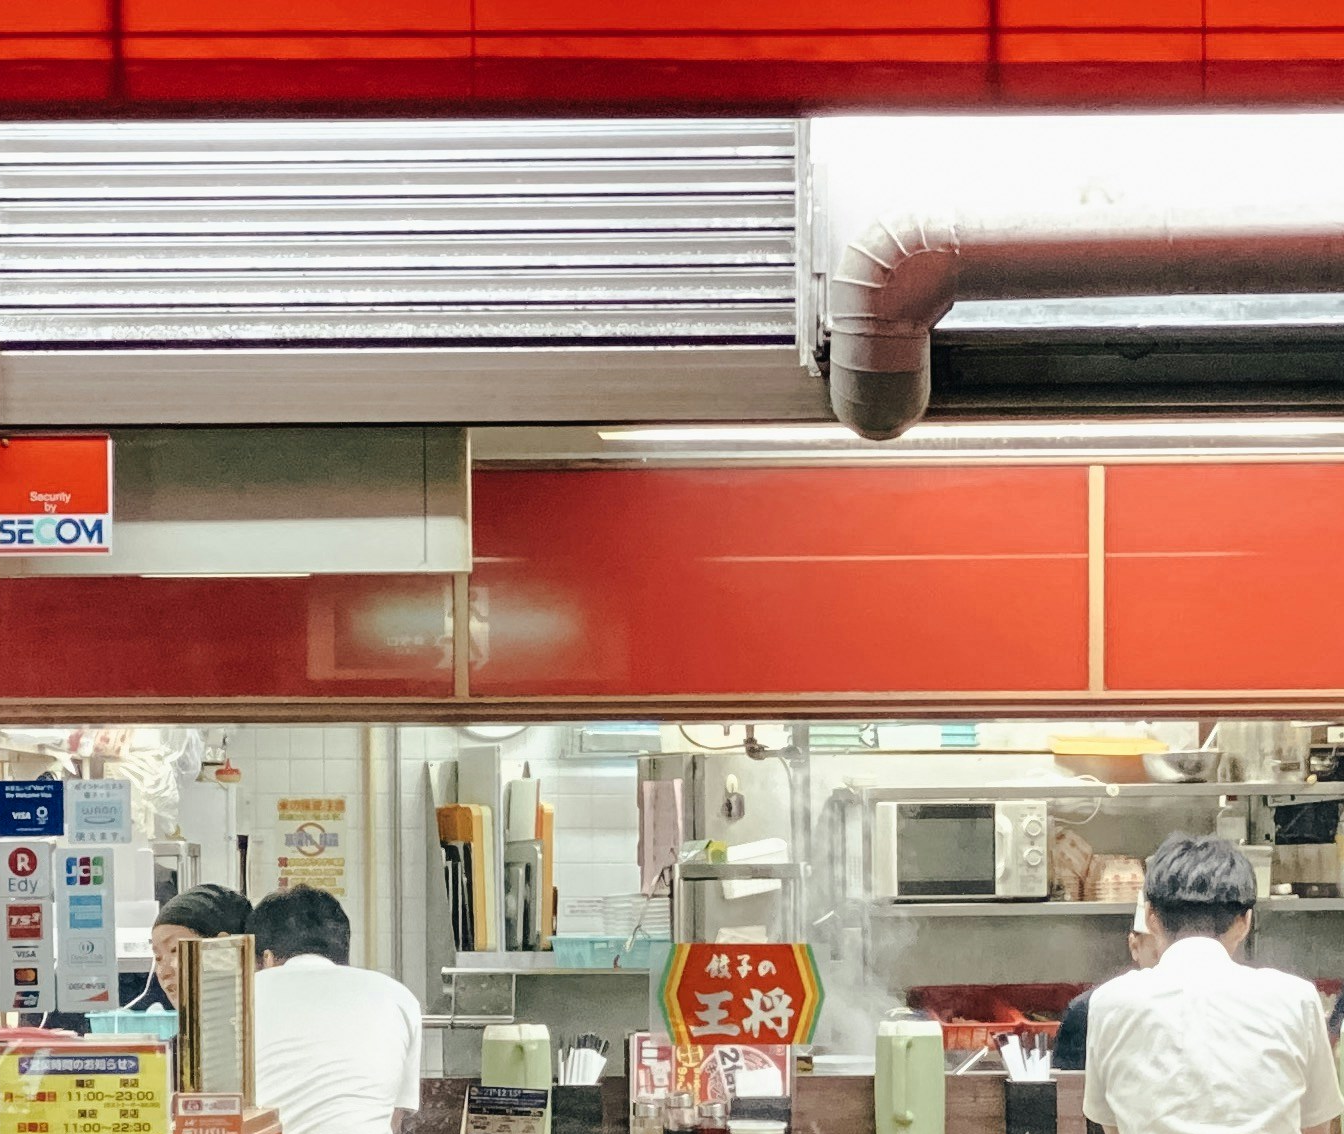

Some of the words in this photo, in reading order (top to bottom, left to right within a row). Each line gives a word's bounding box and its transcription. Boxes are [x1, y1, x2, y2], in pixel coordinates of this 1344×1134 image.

[30, 490, 71, 504] Security
[44, 502, 57, 513] by
[12, 811, 31, 820] VISA
[8, 877, 38, 894] Edy
[705, 954, 777, 978] 餃子の
[689, 987, 794, 1038] 王将
